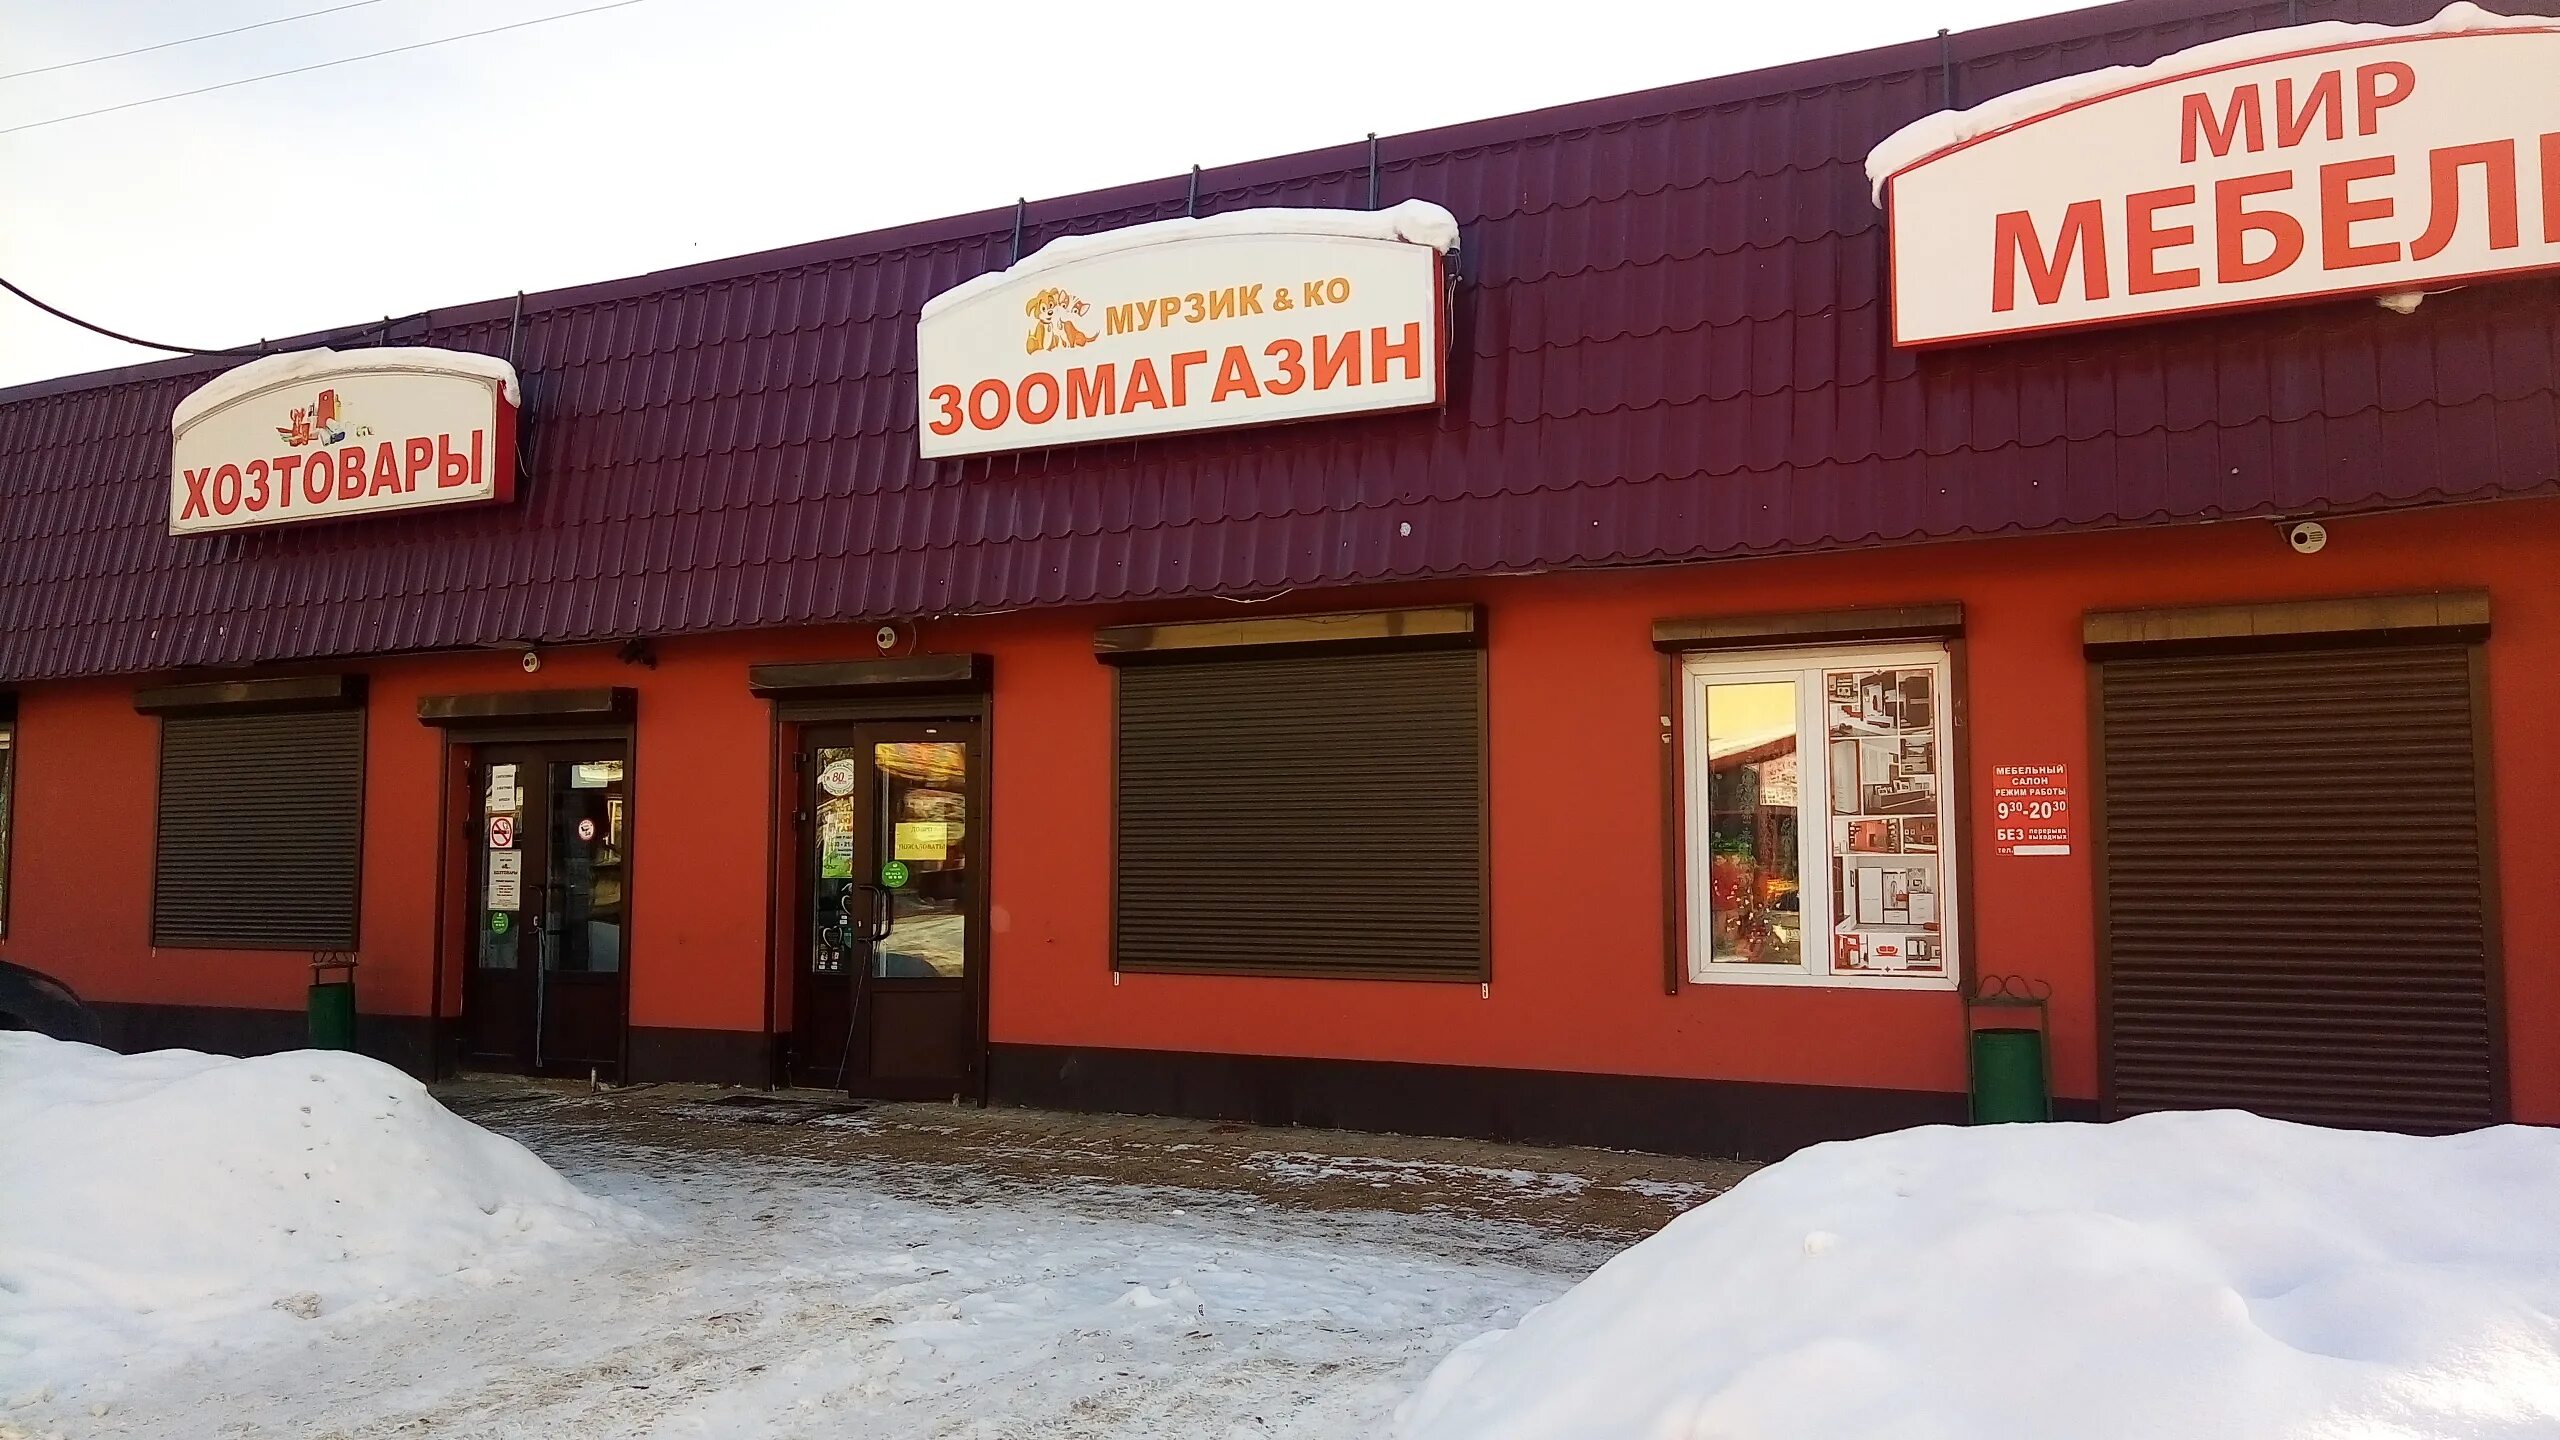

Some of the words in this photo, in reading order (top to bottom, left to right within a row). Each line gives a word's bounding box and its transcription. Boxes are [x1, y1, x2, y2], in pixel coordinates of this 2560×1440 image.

[2180, 60, 2416, 164] МИР
[1105, 283, 1264, 336] МУРЗИК
[1273, 288, 1295, 310] &
[1303, 277, 1351, 307] КО
[928, 322, 1422, 436] ЗООМАГАЗИН
[180, 429, 484, 521] ХОЗТОВАРЫ
[1996, 765, 2064, 775] МЕБЕЛЬНЫЙ
[2012, 777, 2049, 785] САЛОН
[1995, 788, 2027, 796] РЕЖИМ
[2029, 787, 2066, 796] РАБОТЫ
[1997, 829, 2024, 840] БЕЗ
